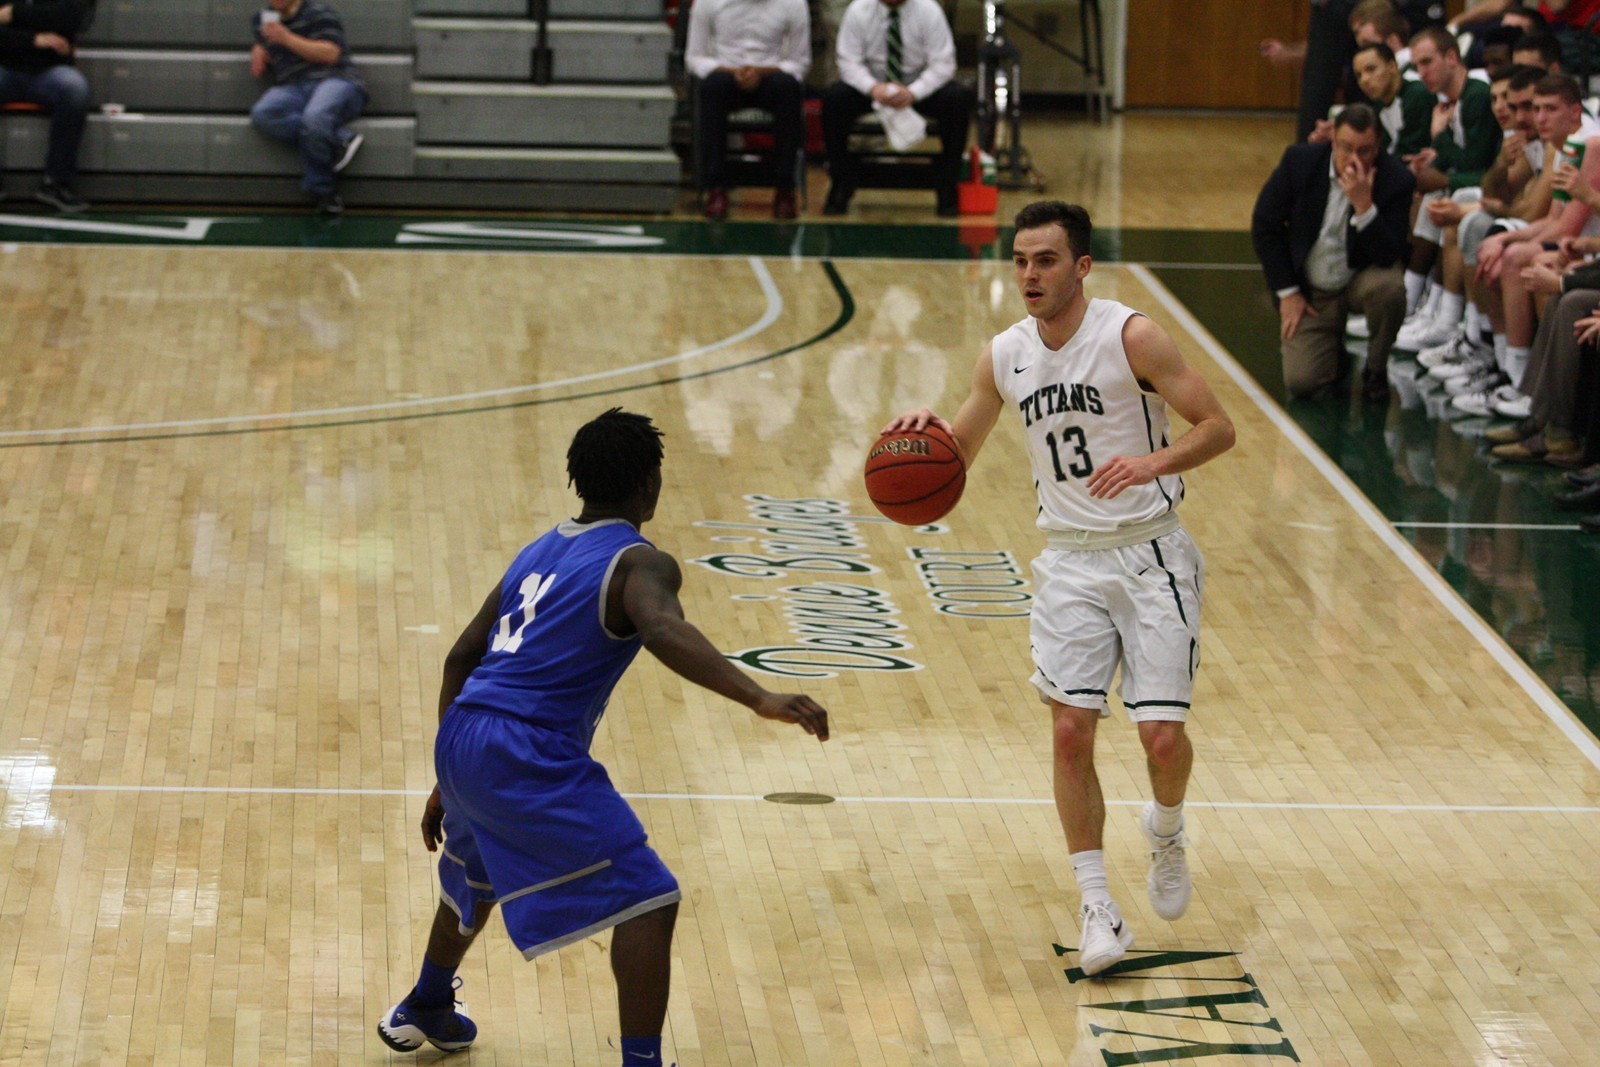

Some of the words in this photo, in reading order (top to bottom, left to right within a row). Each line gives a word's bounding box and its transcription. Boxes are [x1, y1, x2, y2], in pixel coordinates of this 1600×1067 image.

[1019, 382, 1105, 428] TITANS
[1046, 425, 1094, 482] 13
[686, 494, 949, 579] Bridges
[490, 572, 557, 654] 11
[905, 546, 1034, 619] COURT
[722, 582, 925, 680] Dennie
